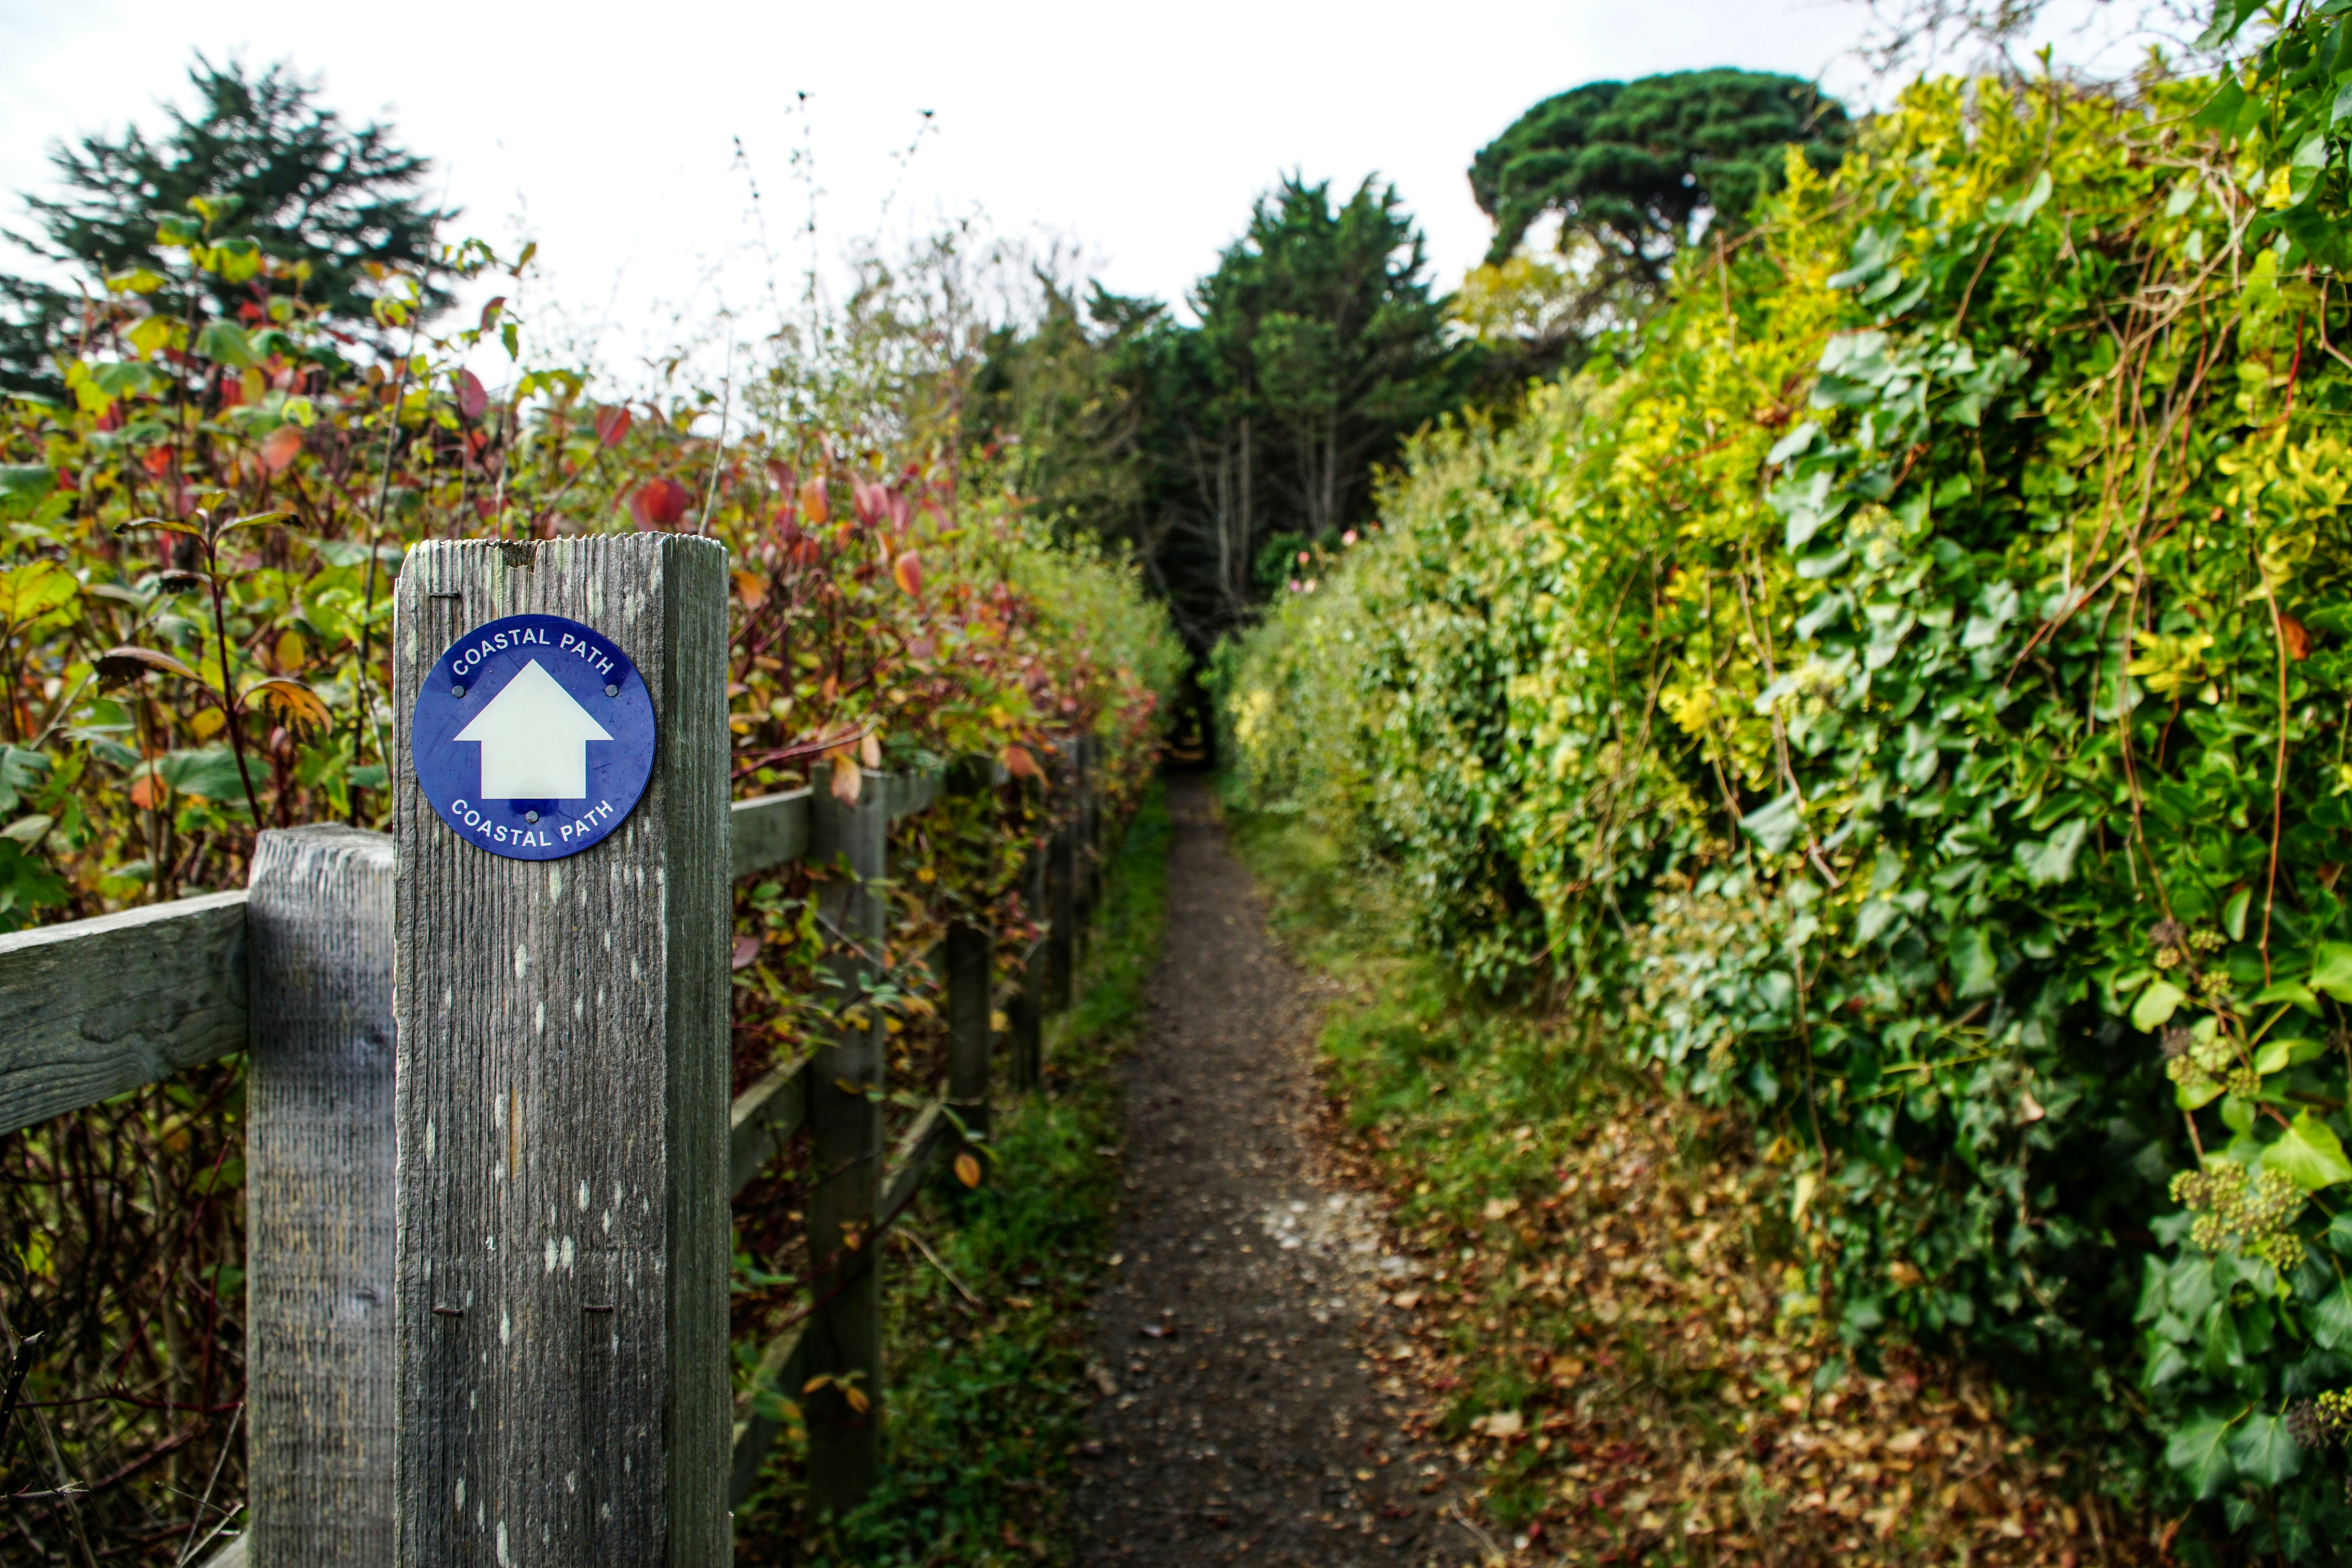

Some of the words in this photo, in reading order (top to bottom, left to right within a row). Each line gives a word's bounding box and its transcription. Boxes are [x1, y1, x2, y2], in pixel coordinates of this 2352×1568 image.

[453, 628, 550, 675] COASTAL
[560, 633, 614, 675] PATH
[452, 799, 552, 847] COASTAL
[560, 800, 614, 842] PATH
